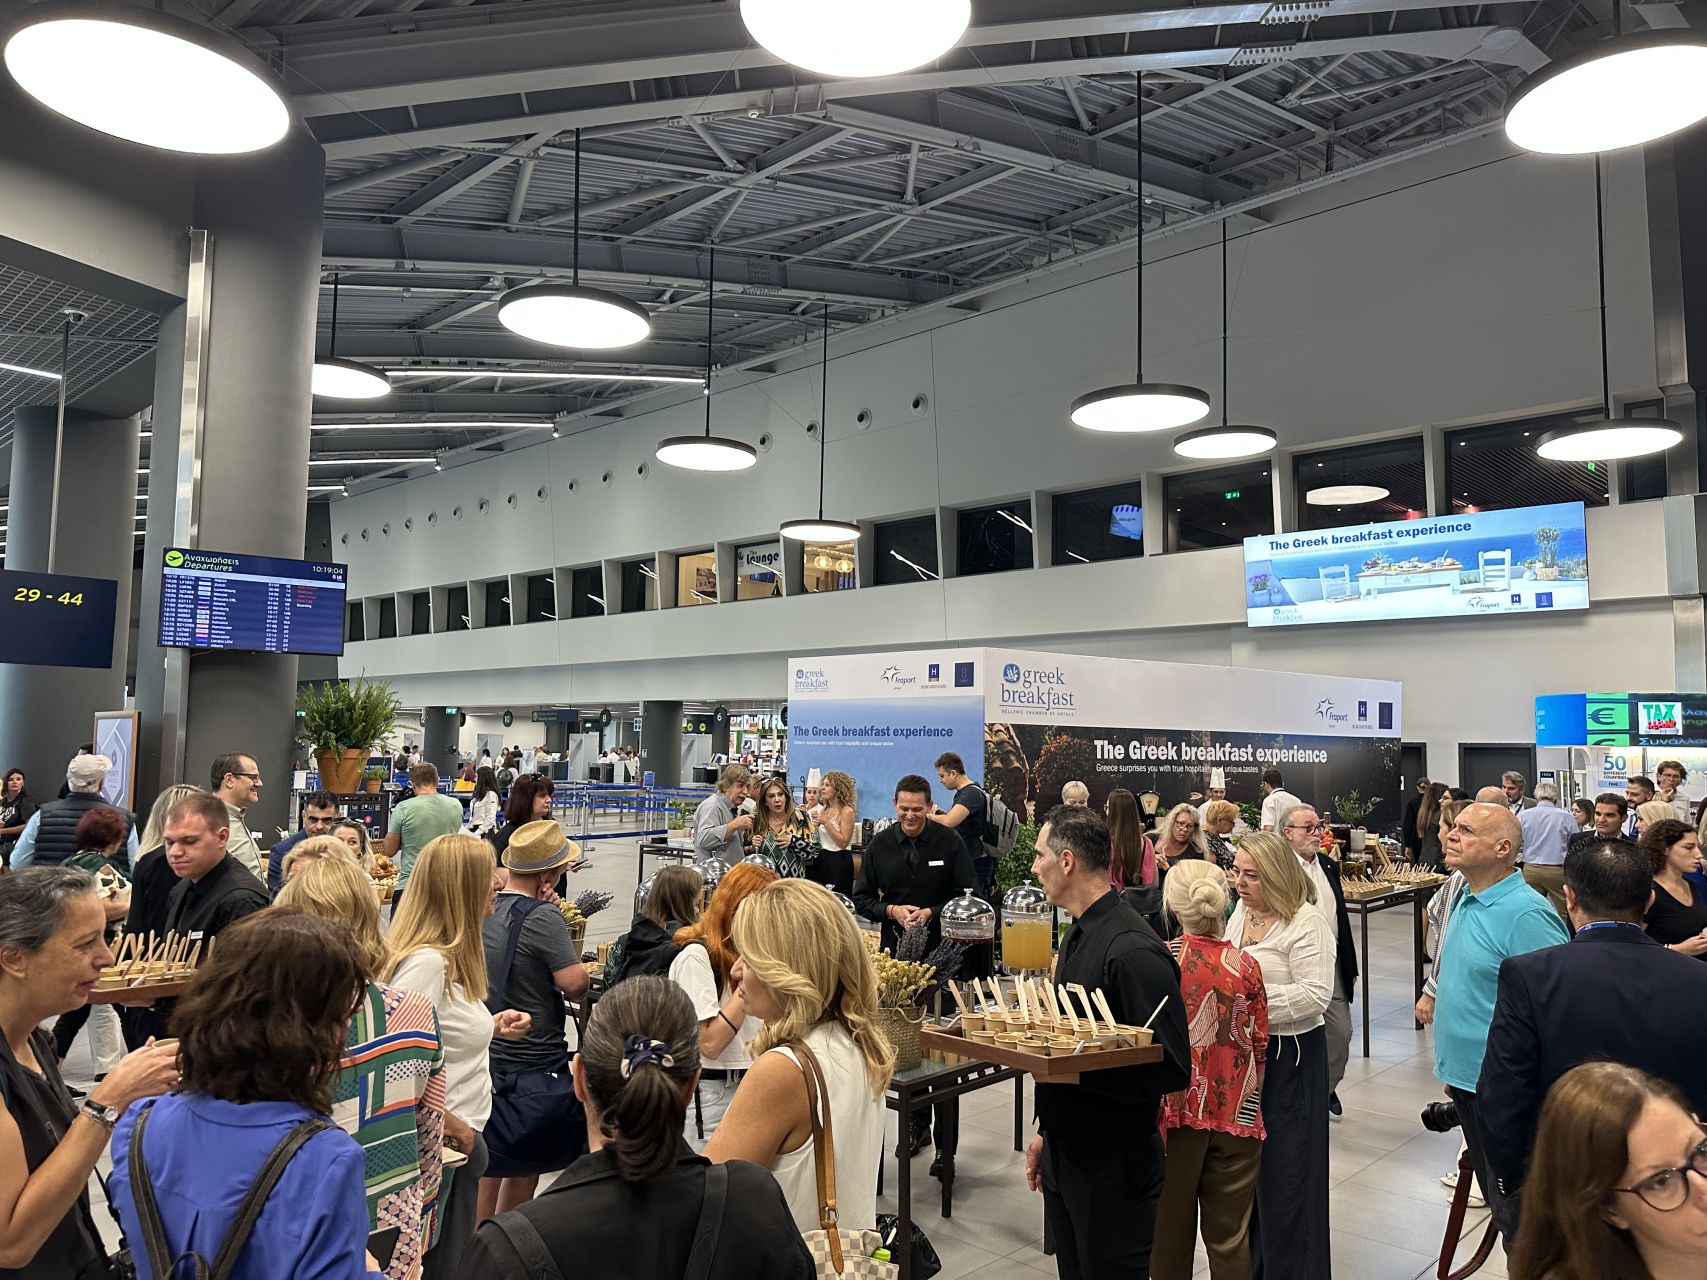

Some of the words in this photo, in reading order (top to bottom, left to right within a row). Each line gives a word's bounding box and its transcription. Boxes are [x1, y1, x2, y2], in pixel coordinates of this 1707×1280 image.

[1269, 541, 1289, 551] The
[1293, 536, 1329, 548] Greek
[1331, 528, 1394, 545] breakfast
[1396, 523, 1472, 539] experience
[184, 561, 233, 572] Departures
[312, 565, 343, 575] 10:19:04
[14, 587, 41, 602] 29
[57, 592, 83, 606] 44
[804, 668, 824, 680] greek
[1022, 667, 1064, 689] greek
[795, 679, 828, 690] breakfast
[1001, 683, 1074, 711] breakfast
[1643, 704, 1676, 721] TAX
[794, 726, 809, 736] The
[812, 726, 840, 737] Greek
[842, 726, 890, 737] breakfast
[893, 726, 953, 738] experience
[1094, 740, 1125, 759] The
[1129, 741, 1178, 760] Greek
[1182, 742, 1253, 761] breakfast
[1256, 745, 1327, 765] experience
[1096, 764, 1118, 772] Greece
[1120, 764, 1146, 773] surprises
[1148, 765, 1158, 773] you
[1604, 755, 1626, 771] 50
